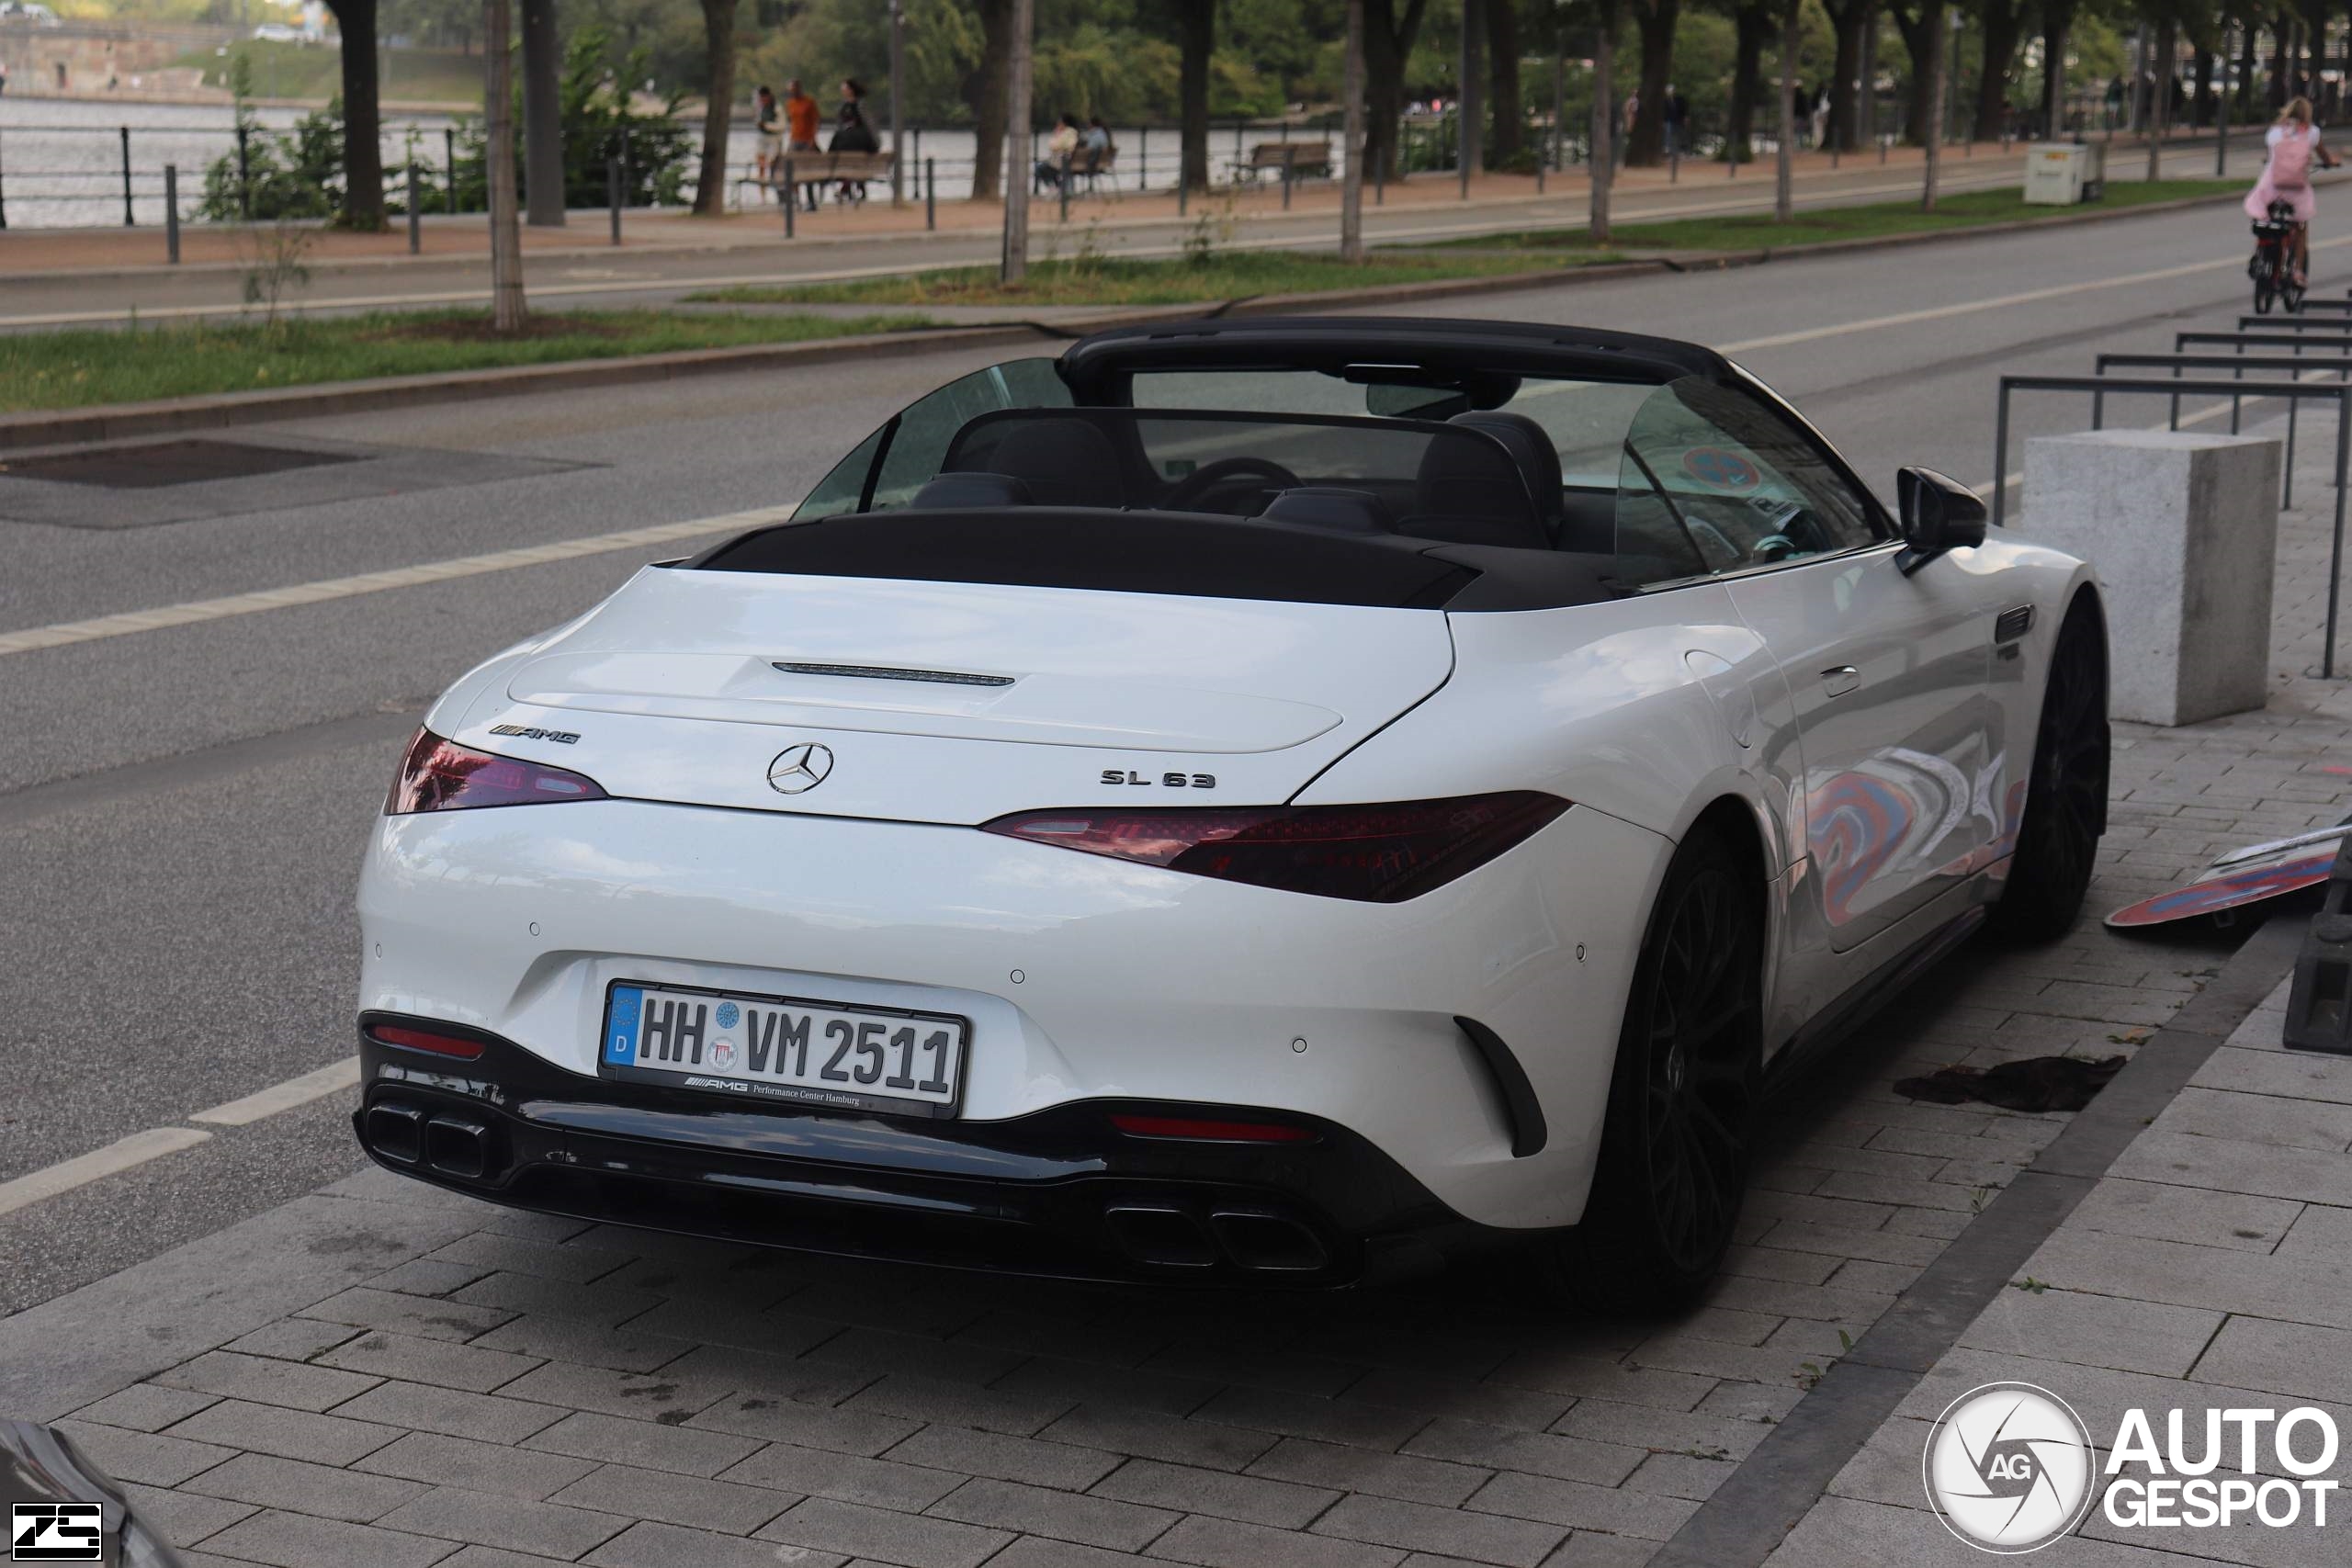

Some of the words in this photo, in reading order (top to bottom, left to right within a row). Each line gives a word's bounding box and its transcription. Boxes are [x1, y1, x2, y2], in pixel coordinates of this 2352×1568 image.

[517, 726, 582, 745] AMG
[1100, 770, 1152, 786] SL
[1161, 772, 1216, 789] 63
[615, 1035, 628, 1053] D
[639, 998, 707, 1065] HH
[747, 1009, 810, 1077] VM
[820, 1019, 949, 1094] 2511
[704, 1078, 749, 1093] AMG
[752, 1084, 798, 1099] Performance
[799, 1090, 824, 1102] Center
[825, 1093, 860, 1106] Hamburg
